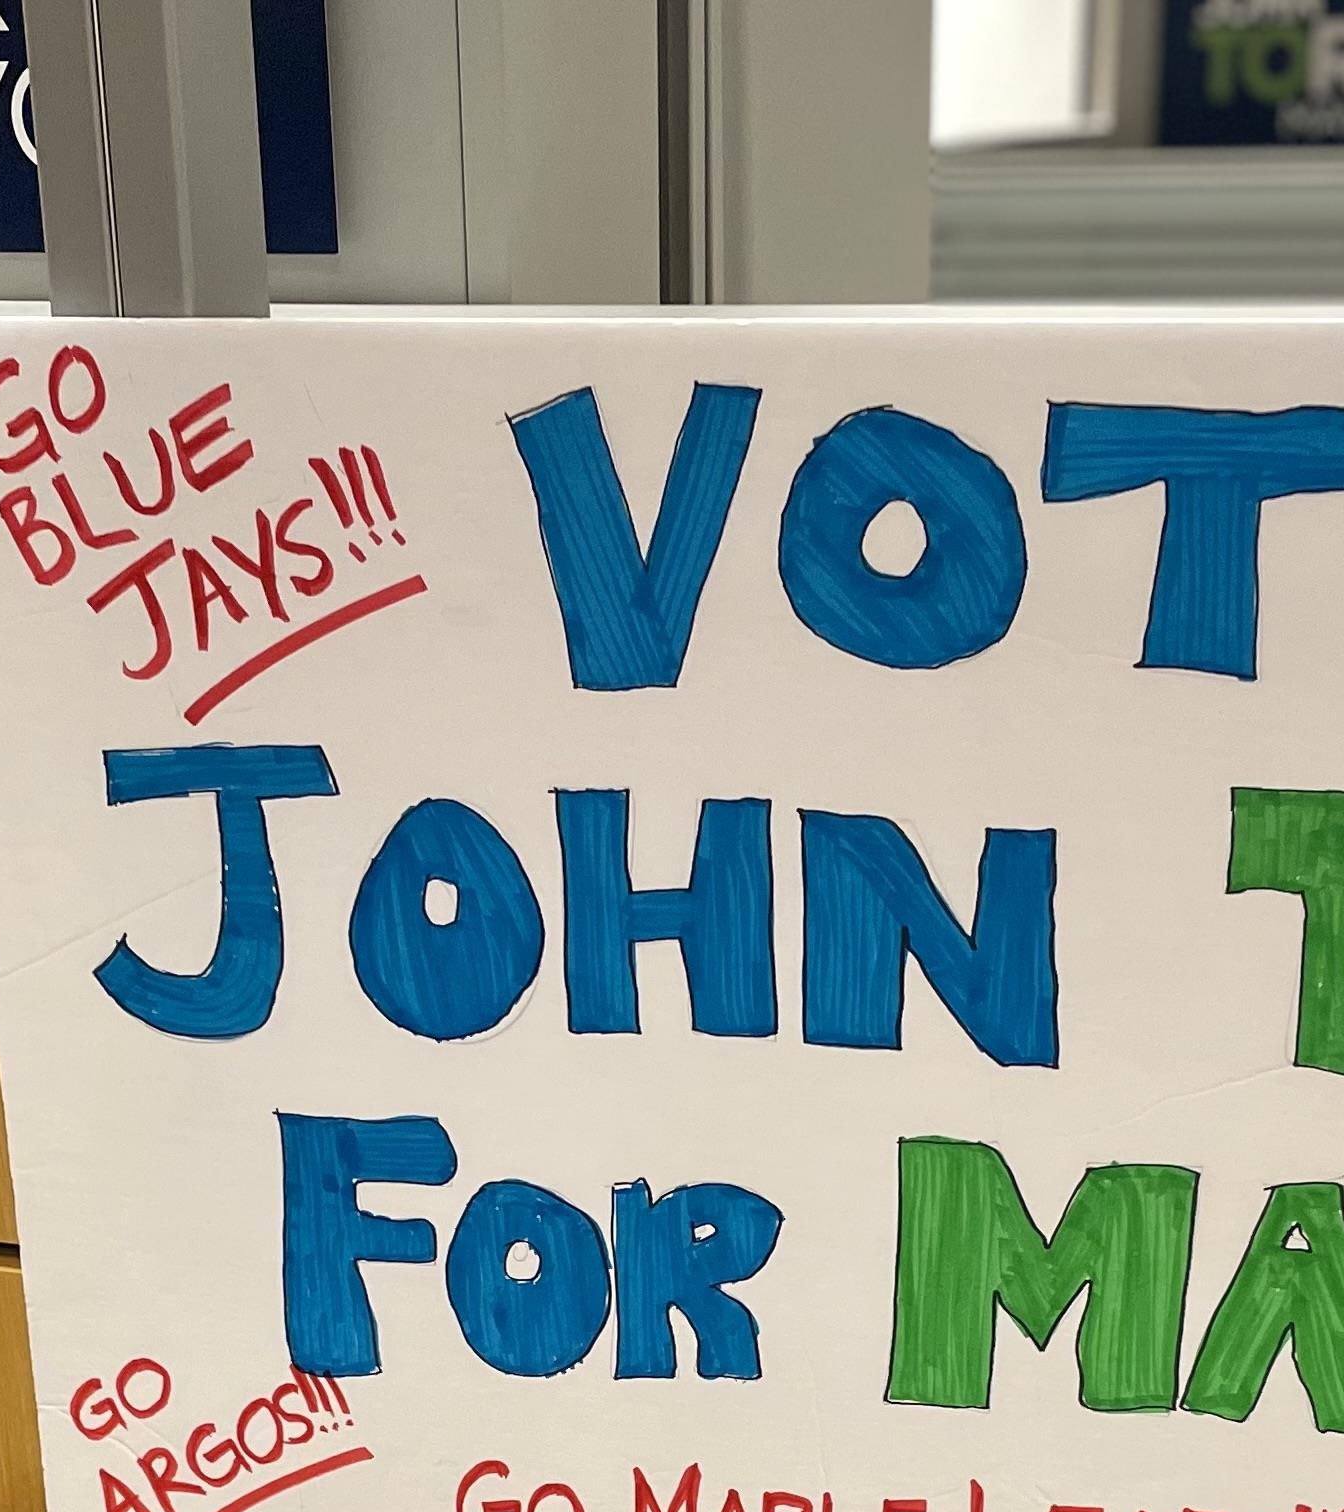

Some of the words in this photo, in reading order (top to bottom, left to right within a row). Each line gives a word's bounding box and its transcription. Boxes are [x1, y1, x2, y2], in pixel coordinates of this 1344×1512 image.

[87, 445, 406, 680] JAYS!!!
[93, 742, 1060, 1070] JOHN
[272, 1108, 786, 1381] FOR
[69, 1357, 172, 1441] GO
